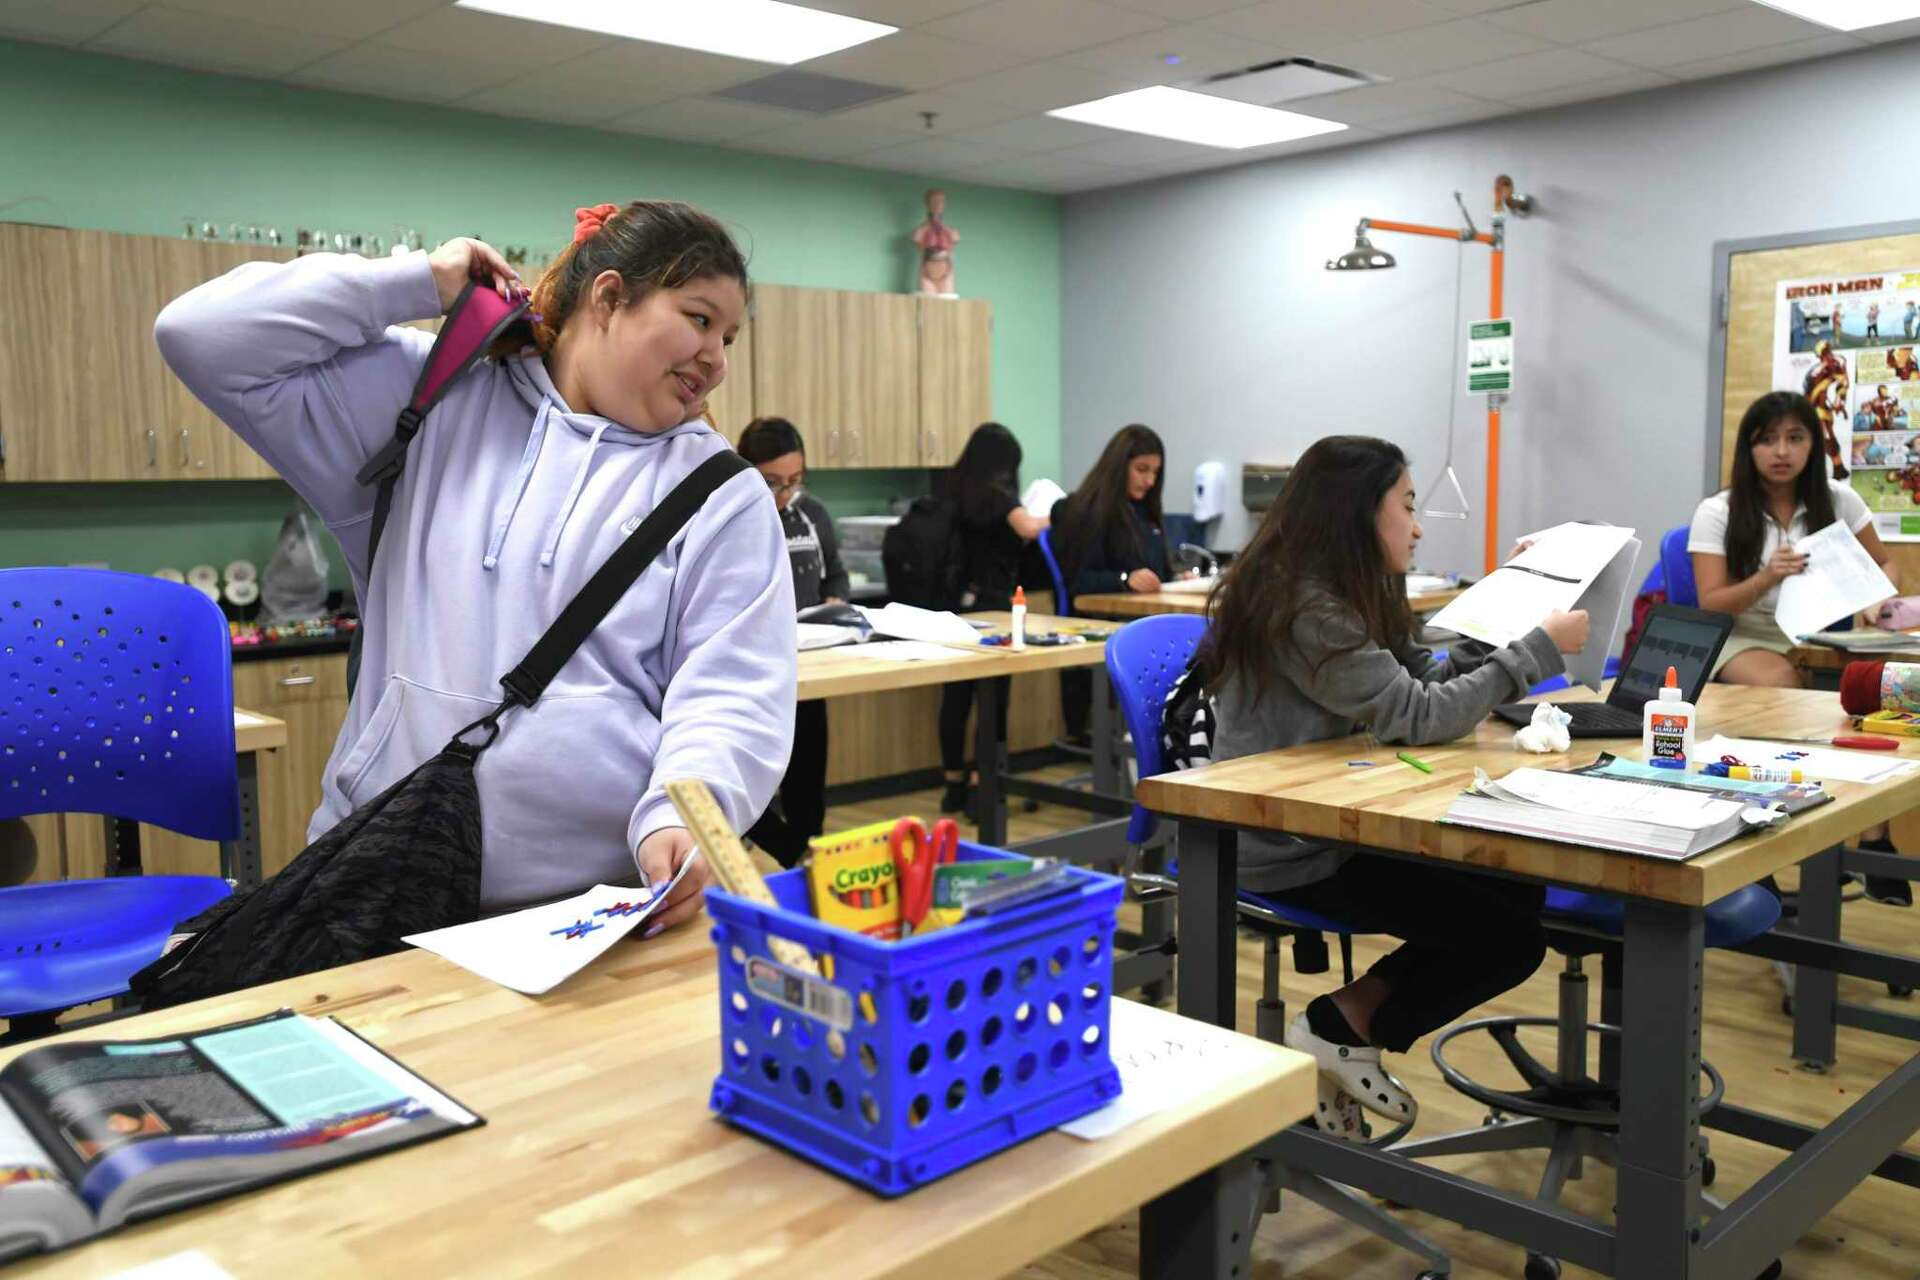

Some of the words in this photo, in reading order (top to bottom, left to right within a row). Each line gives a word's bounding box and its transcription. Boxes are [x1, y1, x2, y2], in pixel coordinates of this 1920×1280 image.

[1786, 283, 1832, 299] IRON
[1838, 278, 1883, 293] MAN
[1656, 740, 1680, 749] School
[1658, 747, 1675, 755] Glue
[836, 862, 893, 888] Crayo
